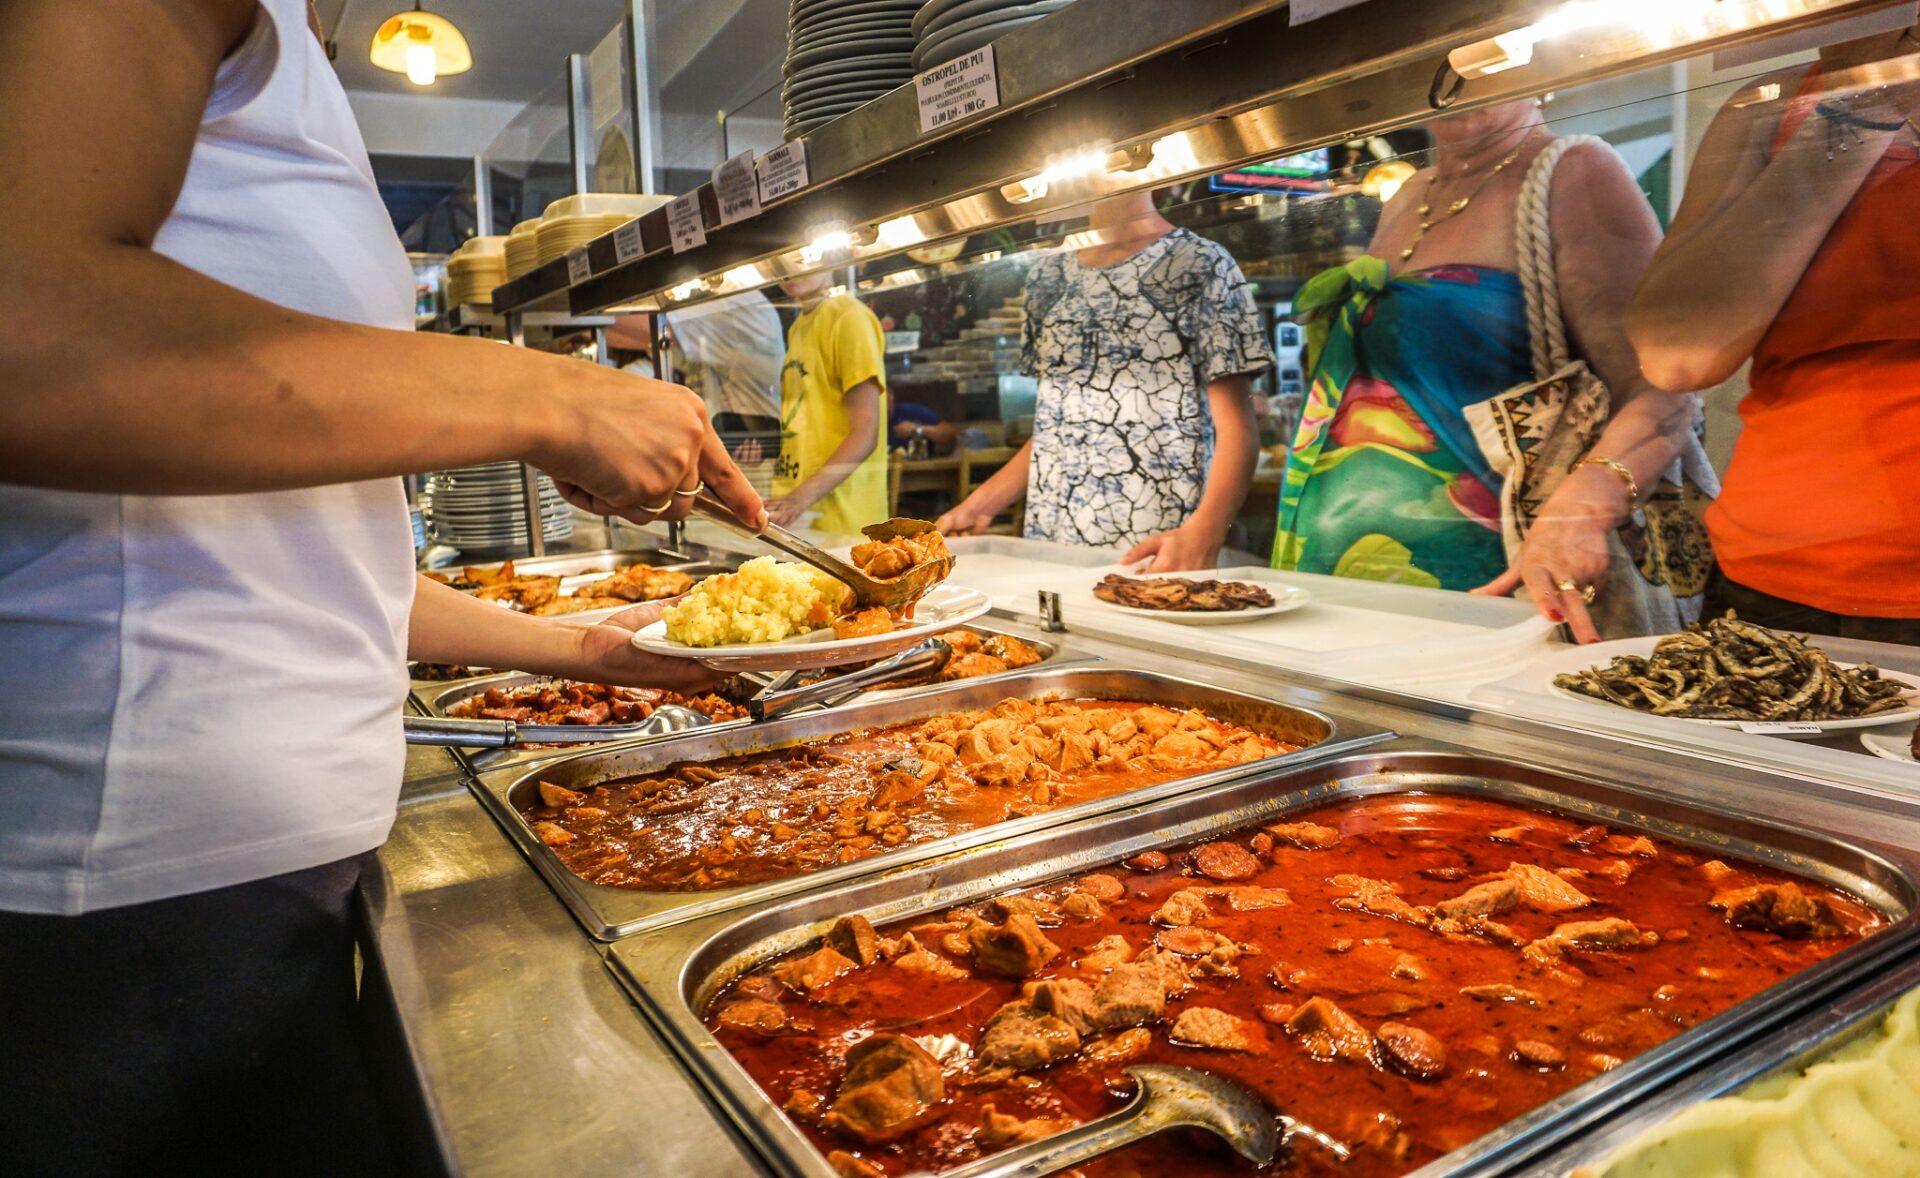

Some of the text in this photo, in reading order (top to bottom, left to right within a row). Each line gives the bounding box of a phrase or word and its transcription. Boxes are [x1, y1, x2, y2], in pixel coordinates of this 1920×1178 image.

[922, 52, 984, 87] OSTROPEL DE PUI
[976, 97, 986, 110] Gr
